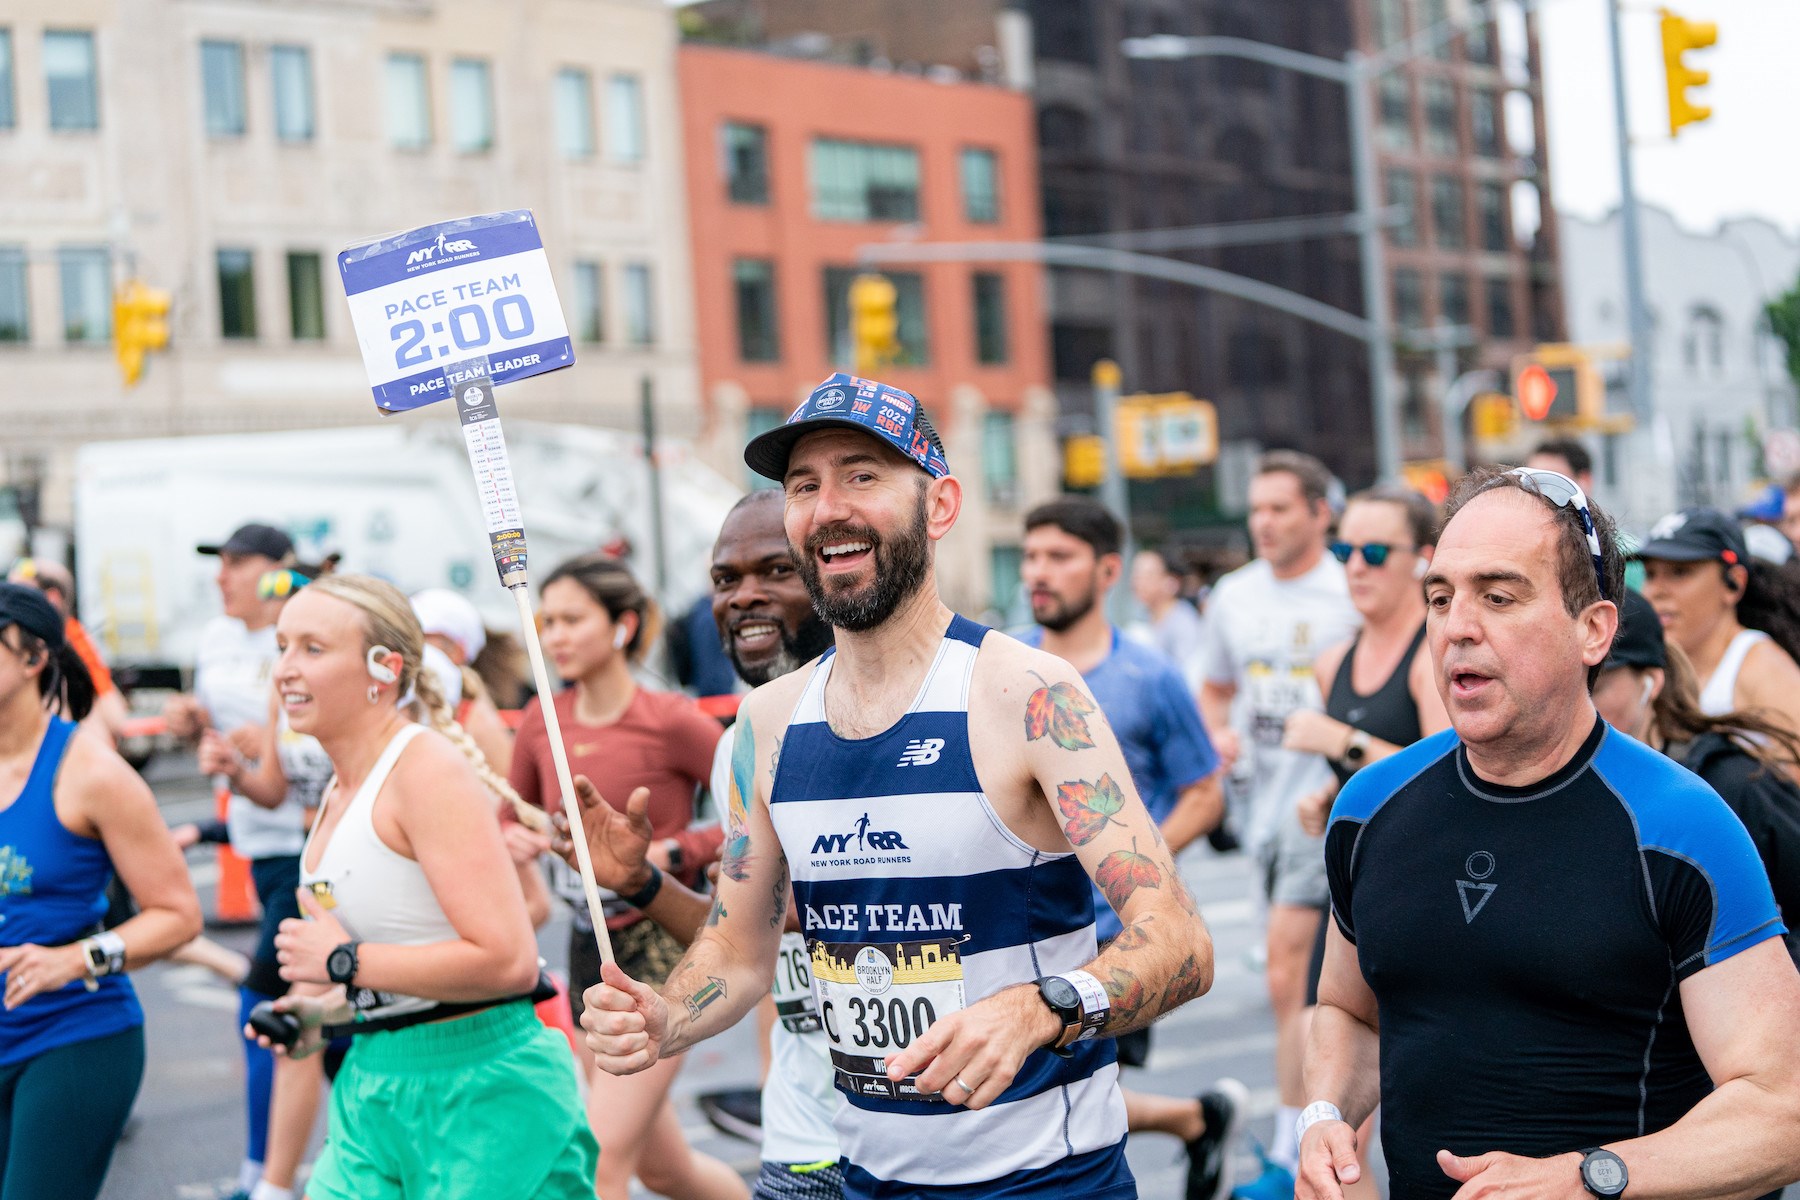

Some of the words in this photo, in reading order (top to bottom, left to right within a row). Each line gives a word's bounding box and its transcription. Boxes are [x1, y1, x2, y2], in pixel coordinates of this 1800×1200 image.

[407, 264, 421, 273] NEW
[421, 261, 436, 270] YORK
[437, 257, 453, 266] ROAD
[453, 251, 480, 263] RUNNERS
[385, 290, 447, 320] PACE
[453, 273, 521, 301] TEAM
[390, 294, 535, 370] 2:00
[409, 377, 445, 396] PACE
[447, 366, 485, 385] TEAM
[488, 353, 541, 374] LEADER
[881, 393, 913, 414] FINISH
[876, 413, 903, 437] RBC
[879, 405, 906, 426] 2023
[496, 531, 521, 541] 2:00:00
[811, 831, 910, 854] NYRR
[829, 859, 851, 867] YORK
[853, 857, 876, 865] ROAD
[877, 856, 912, 864] RUNNERS
[804, 903, 859, 931] ACE
[865, 903, 963, 932] TEAM
[857, 965, 890, 975] BROOKLYN
[866, 975, 882, 985] HALF
[822, 1000, 841, 1044] C
[848, 996, 937, 1049] 3300
